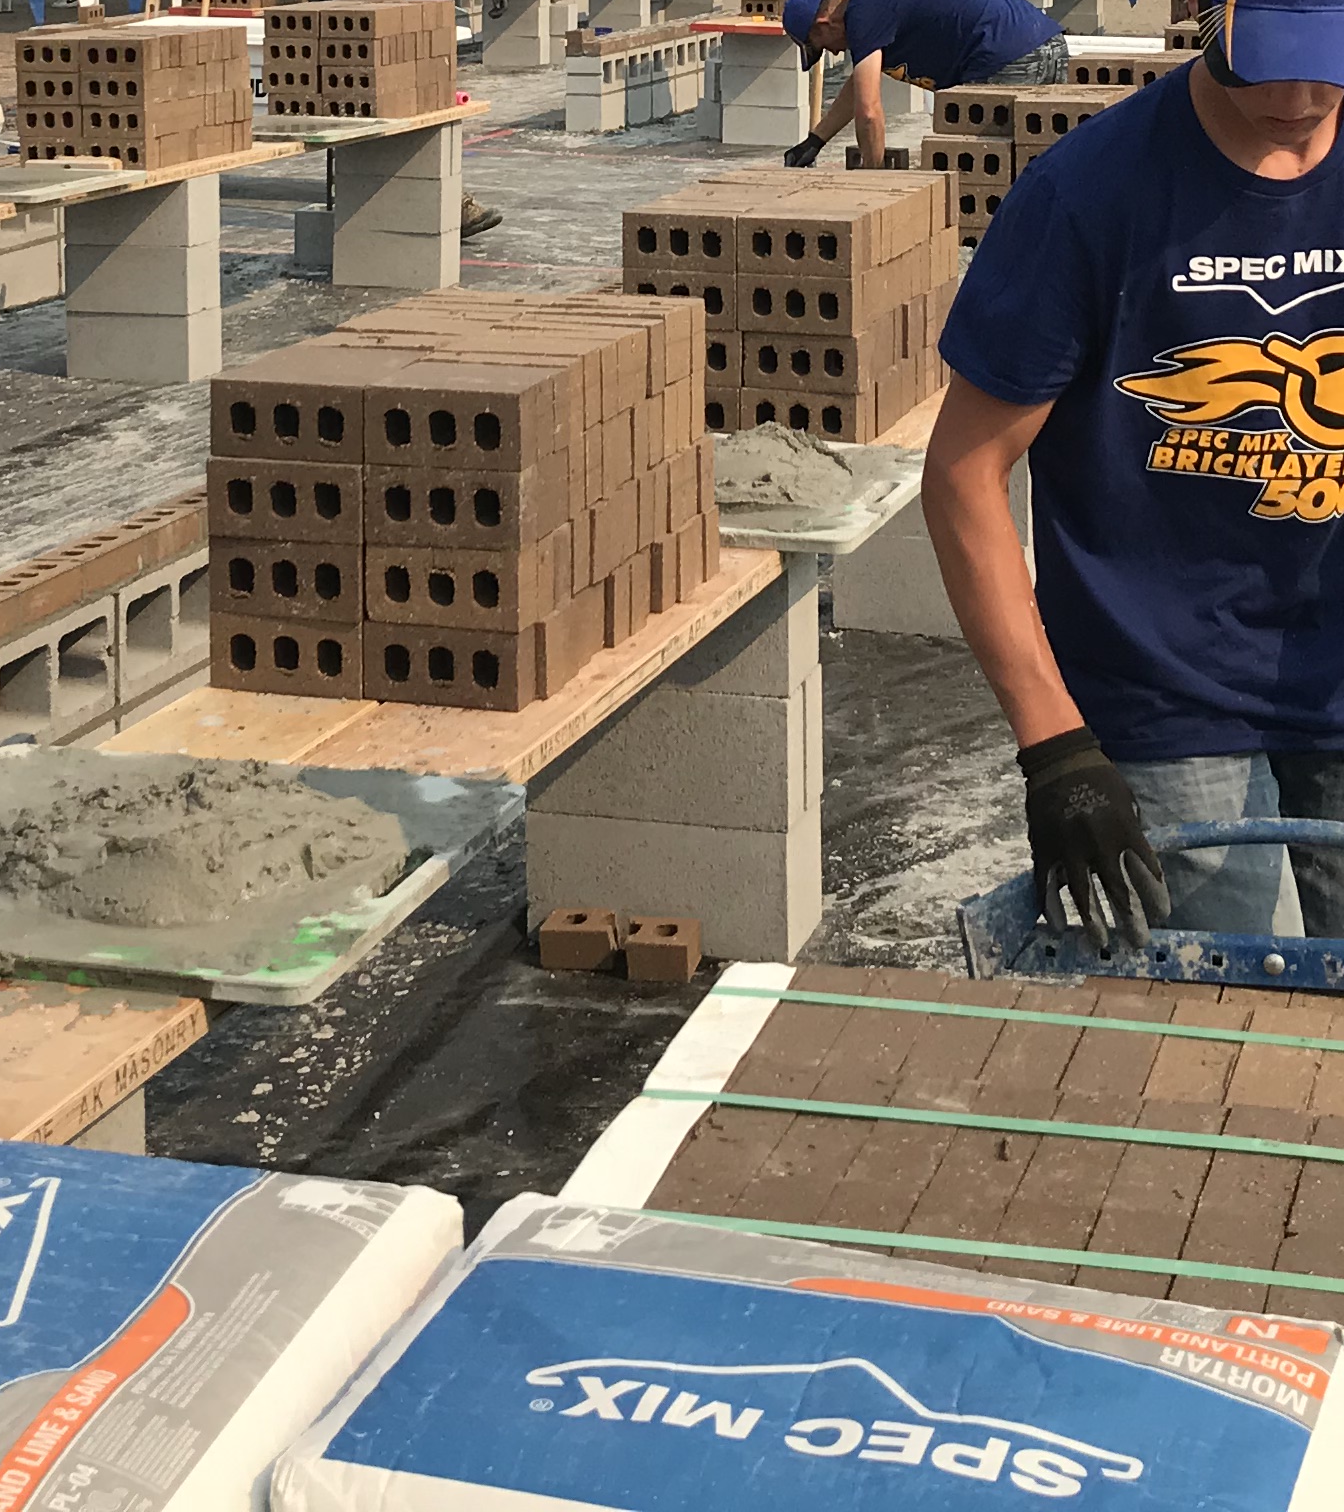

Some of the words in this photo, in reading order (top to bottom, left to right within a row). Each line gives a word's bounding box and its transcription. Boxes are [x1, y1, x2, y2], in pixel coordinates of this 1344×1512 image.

[1188, 254, 1286, 282] SPEC
[1166, 430, 1229, 449] SPEC
[1238, 432, 1291, 452] MIX
[78, 1081, 104, 1125] AK
[114, 1008, 200, 1096] MASONRY
[986, 1300, 1062, 1321] SAND
[1067, 1311, 1091, 1322] &
[1093, 1316, 1164, 1340] LIME
[1234, 1318, 1282, 1340] N
[1169, 1328, 1317, 1389] PORTLAND
[65, 1368, 119, 1408] SAND
[1158, 1345, 1309, 1417] MORTAR
[53, 1406, 82, 1422] &
[558, 1375, 765, 1439] MIX
[15, 1420, 70, 1467] LIME
[784, 1416, 1090, 1498] SPEC
[46, 1463, 99, 1512] PL-04
